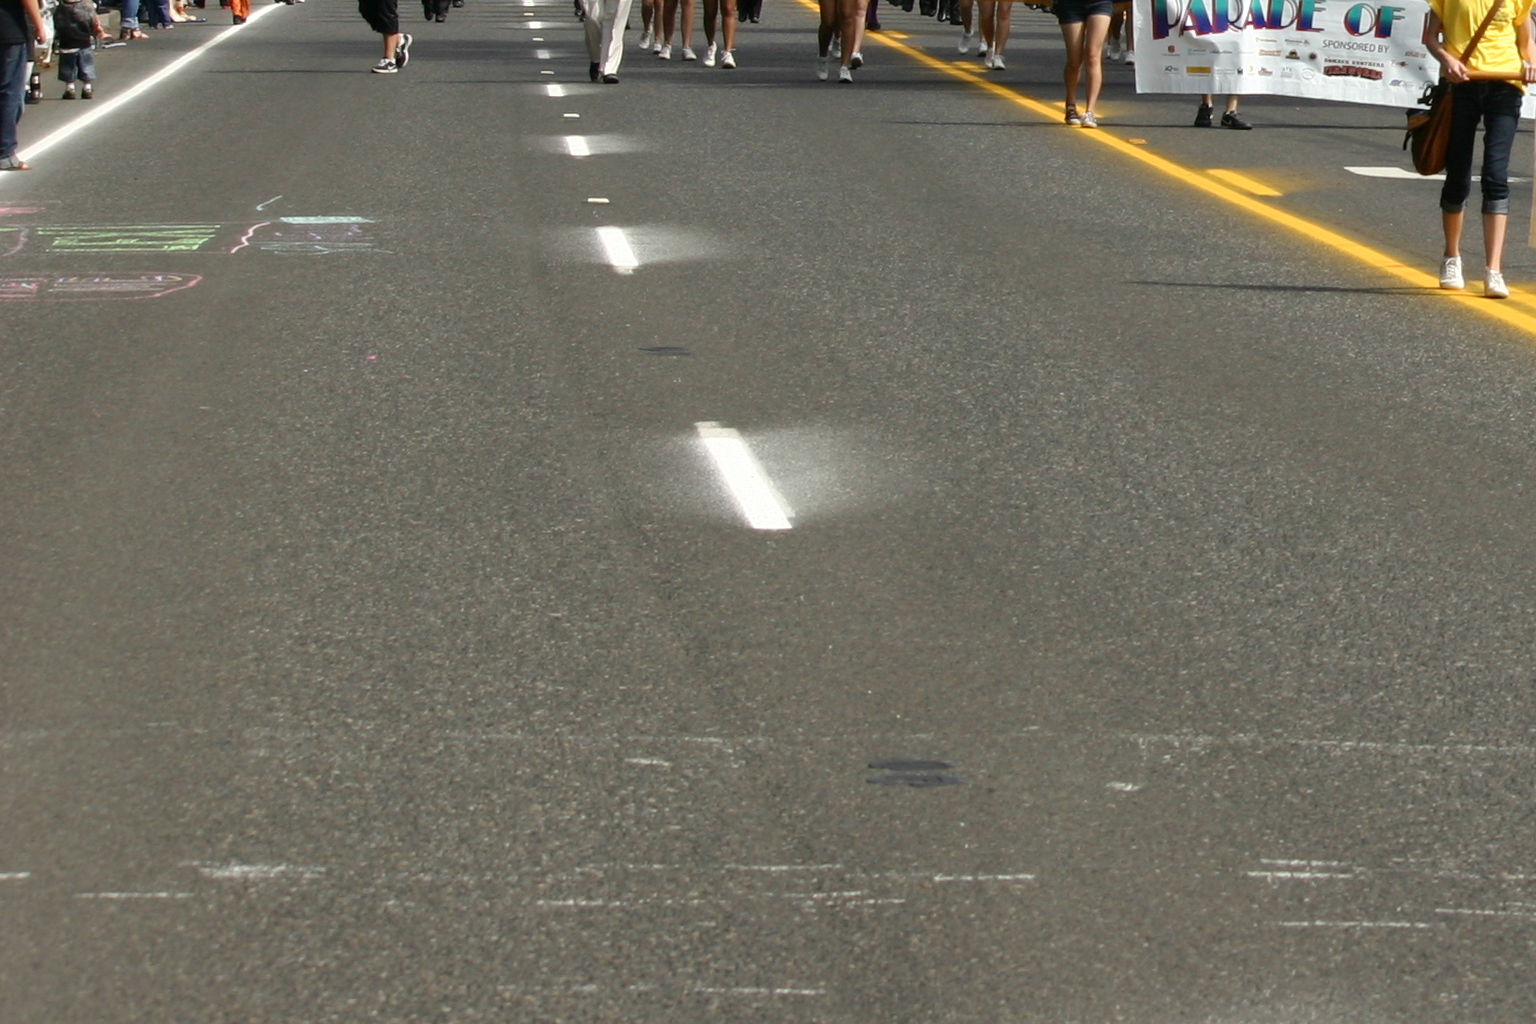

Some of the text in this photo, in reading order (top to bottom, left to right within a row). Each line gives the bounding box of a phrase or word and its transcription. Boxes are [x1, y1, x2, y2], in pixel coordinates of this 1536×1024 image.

[1343, 3, 1406, 38] OF
[1322, 39, 1390, 53] SPONSORED BY
